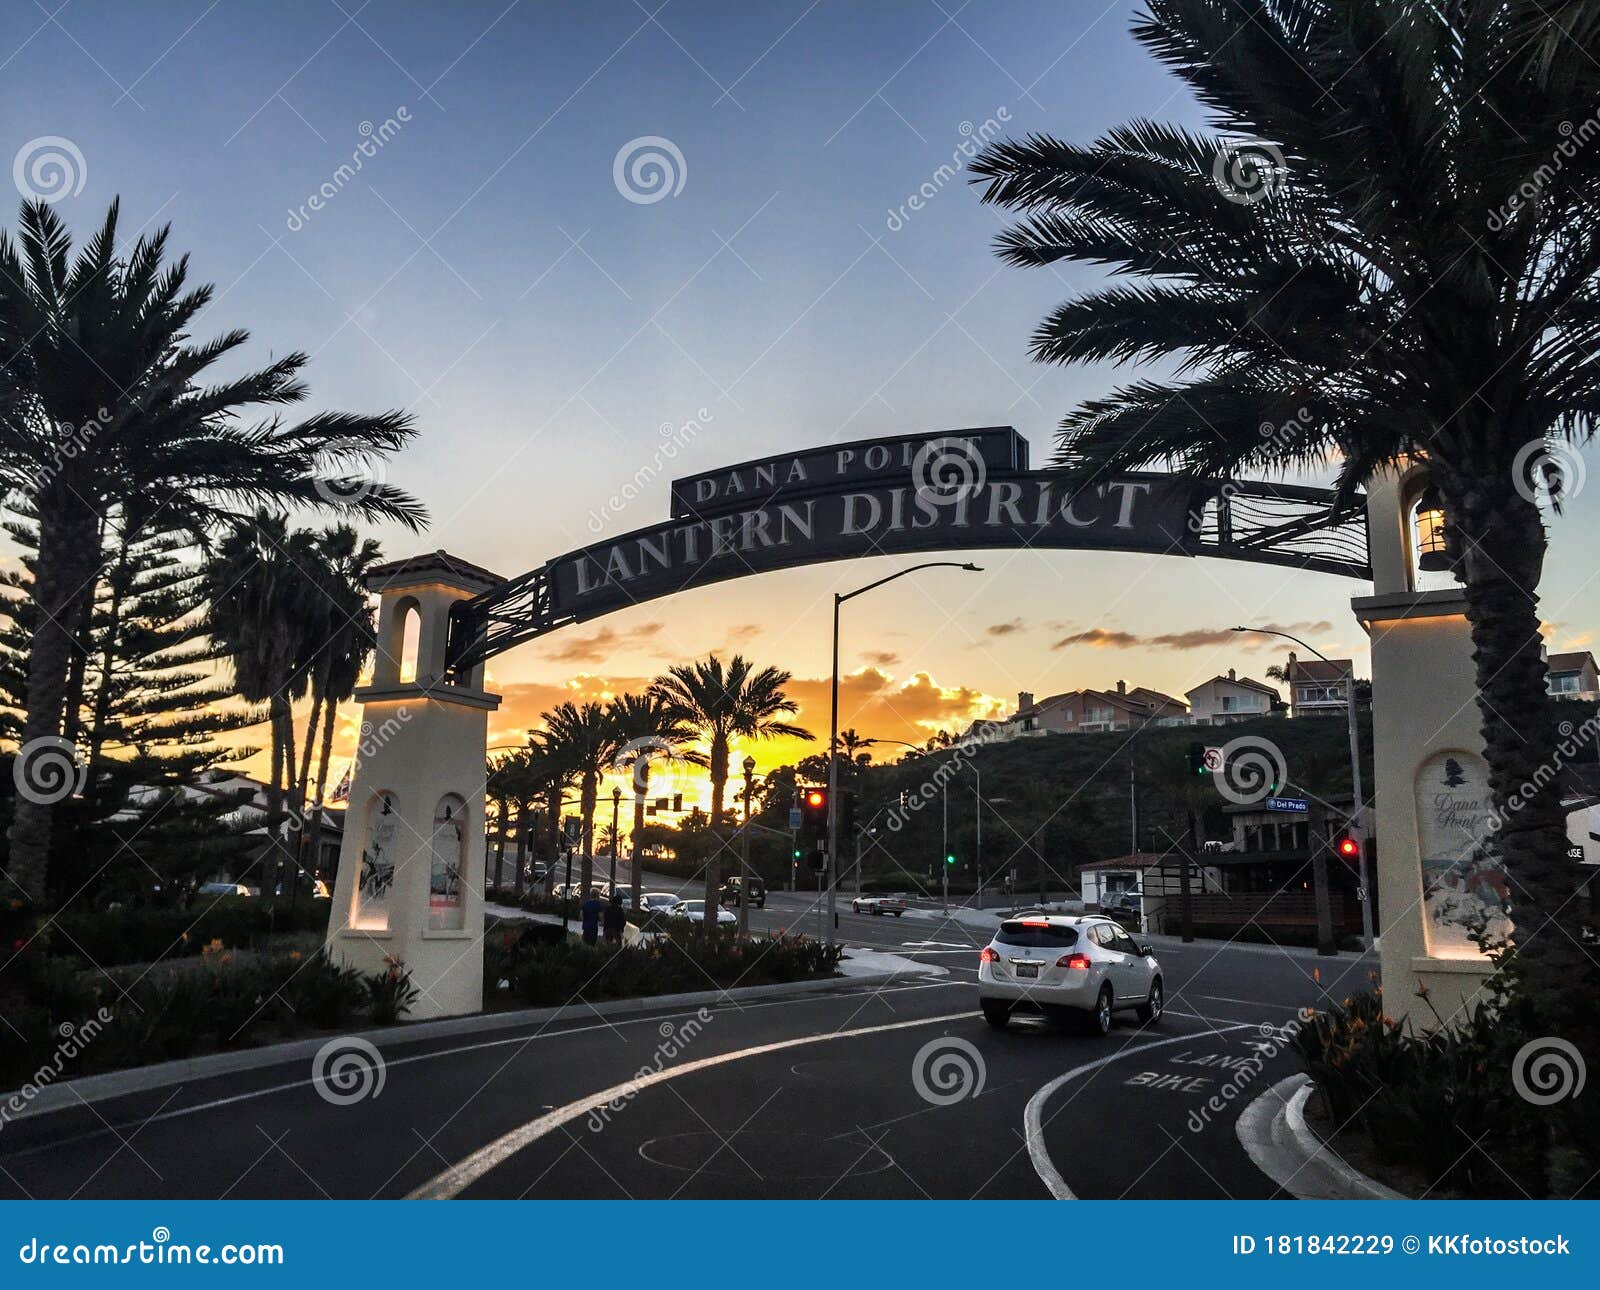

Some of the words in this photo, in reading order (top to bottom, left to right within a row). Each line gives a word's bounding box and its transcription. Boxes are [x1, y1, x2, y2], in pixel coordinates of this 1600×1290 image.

[695, 458, 807, 503] DANA
[836, 435, 983, 475] POINT
[573, 499, 817, 597] LANTERN
[839, 480, 1151, 537] DISTRICT
[1276, 801, 1288, 809] Del
[1434, 793, 1479, 812] Dana
[1566, 848, 1583, 858] USE
[1168, 1051, 1259, 1070] LANE
[1124, 1071, 1213, 1093] BIKE
